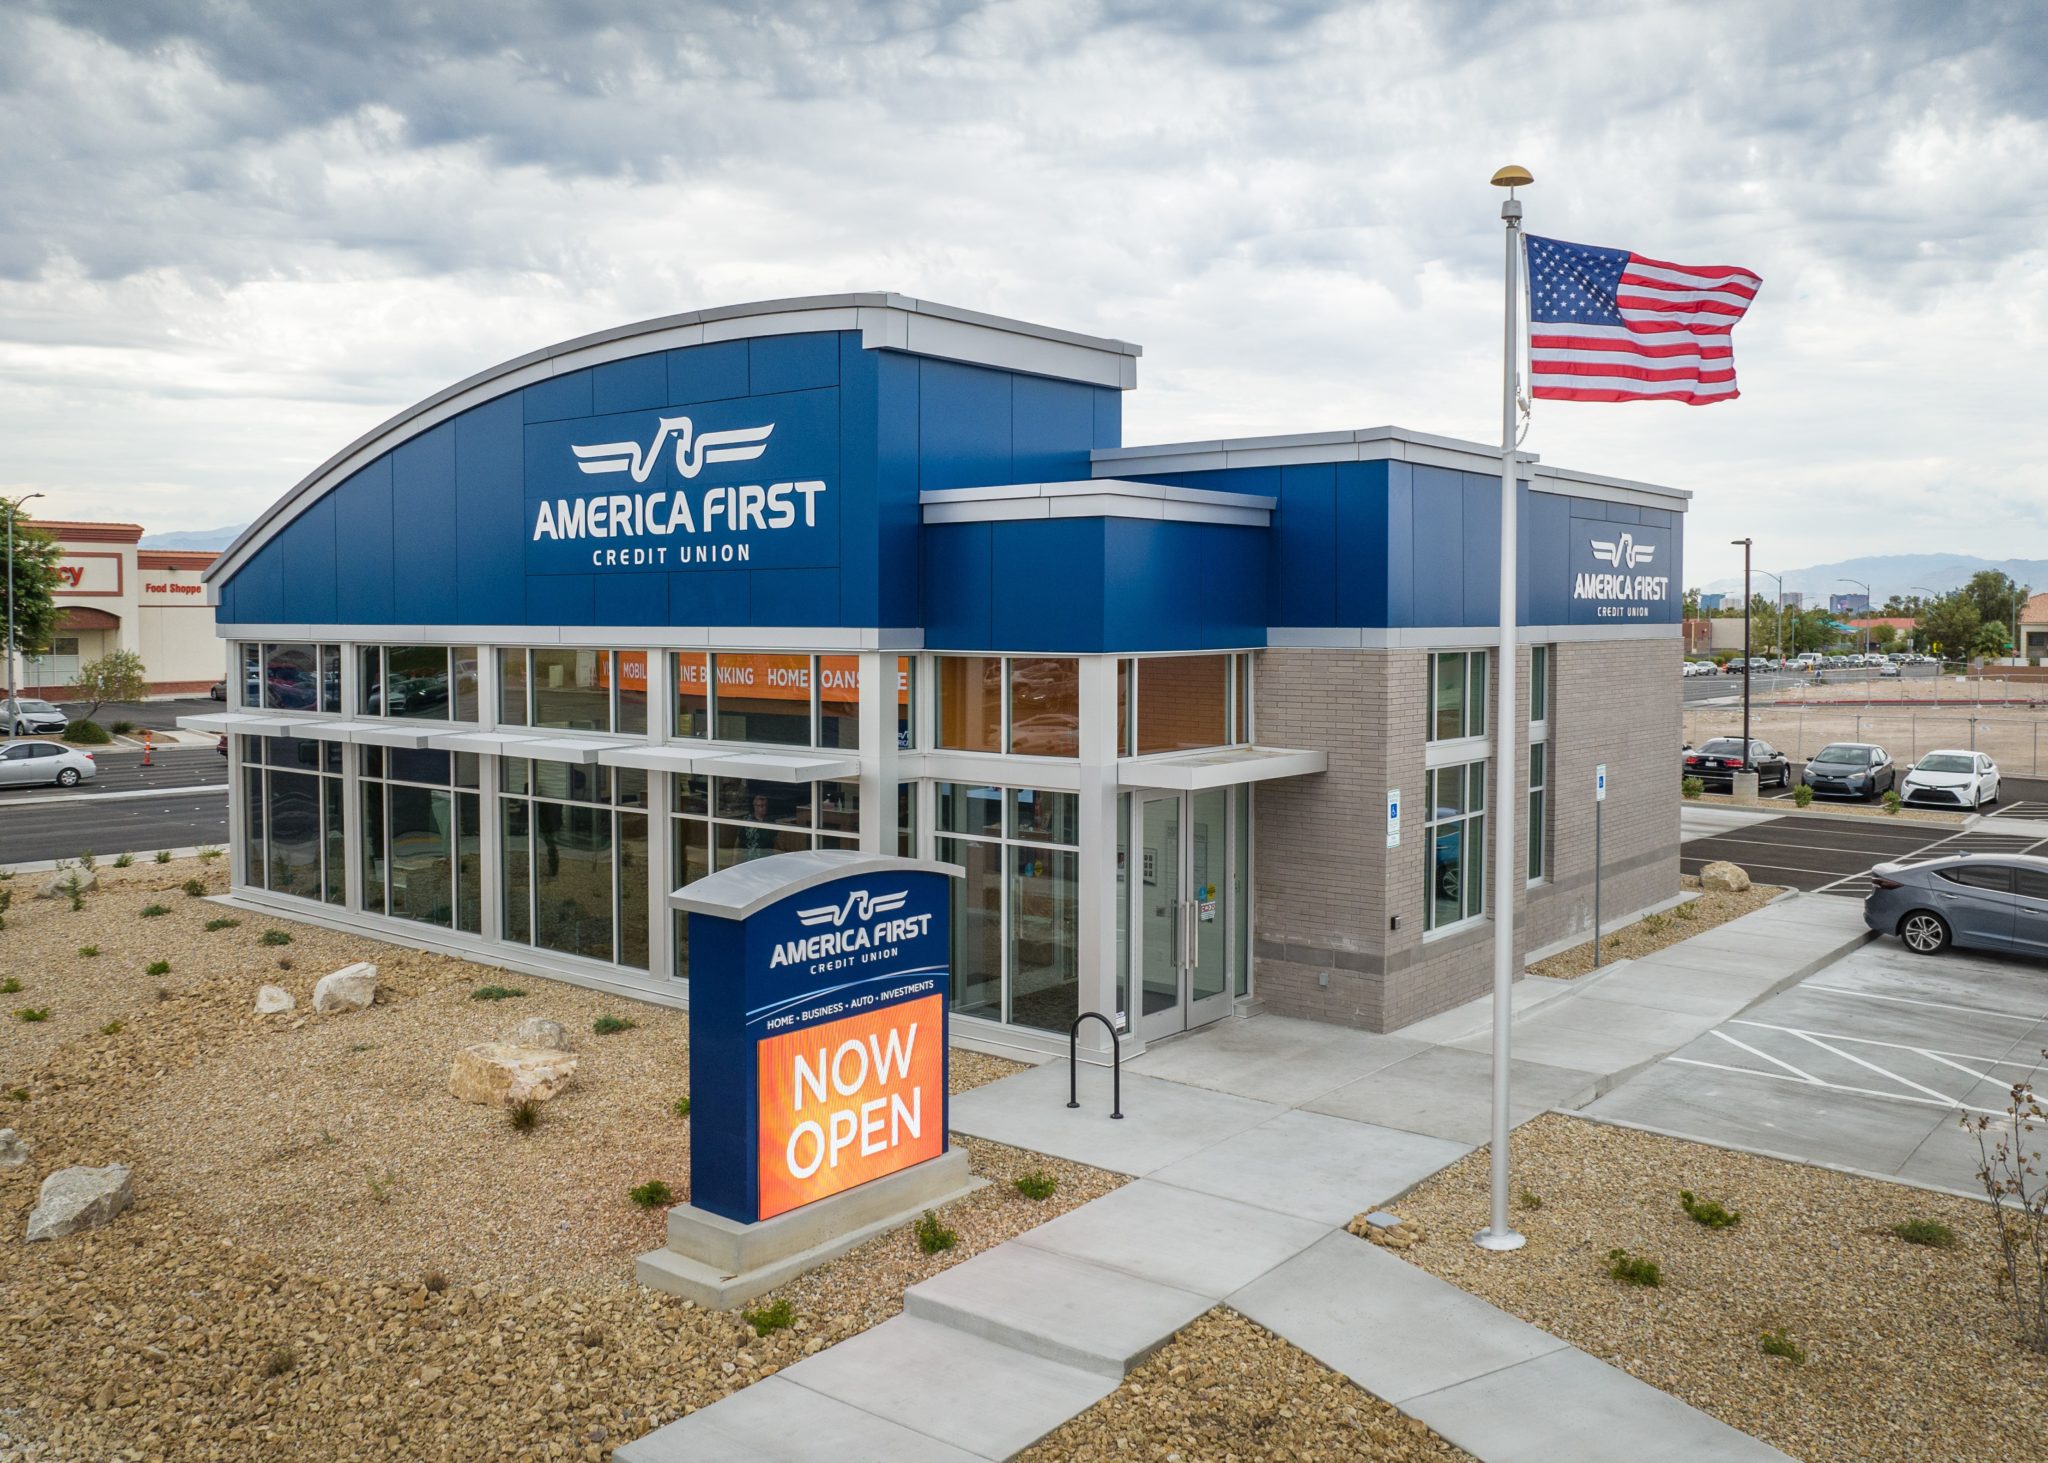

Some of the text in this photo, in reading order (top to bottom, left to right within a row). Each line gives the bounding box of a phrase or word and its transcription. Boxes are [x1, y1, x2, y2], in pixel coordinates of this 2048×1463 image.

[533, 480, 827, 541] AMERICA FIRST
[592, 543, 750, 566] CREDIT UNION
[145, 583, 202, 595] Food Shoppe
[1573, 572, 1668, 601] AMERICA FIRST
[1597, 606, 1649, 617] CREDIT UNION
[623, 662, 648, 679] MOBIL
[700, 665, 754, 685] BNKING
[767, 668, 809, 687] HOME
[769, 913, 932, 969] AMERICA FIRST
[810, 947, 899, 975] CREDIT UNION
[767, 980, 934, 1030] HOME BUSINESS AUTO INVESTMENTS
[794, 1022, 918, 1112] NOW
[786, 1086, 921, 1179] OPEN
